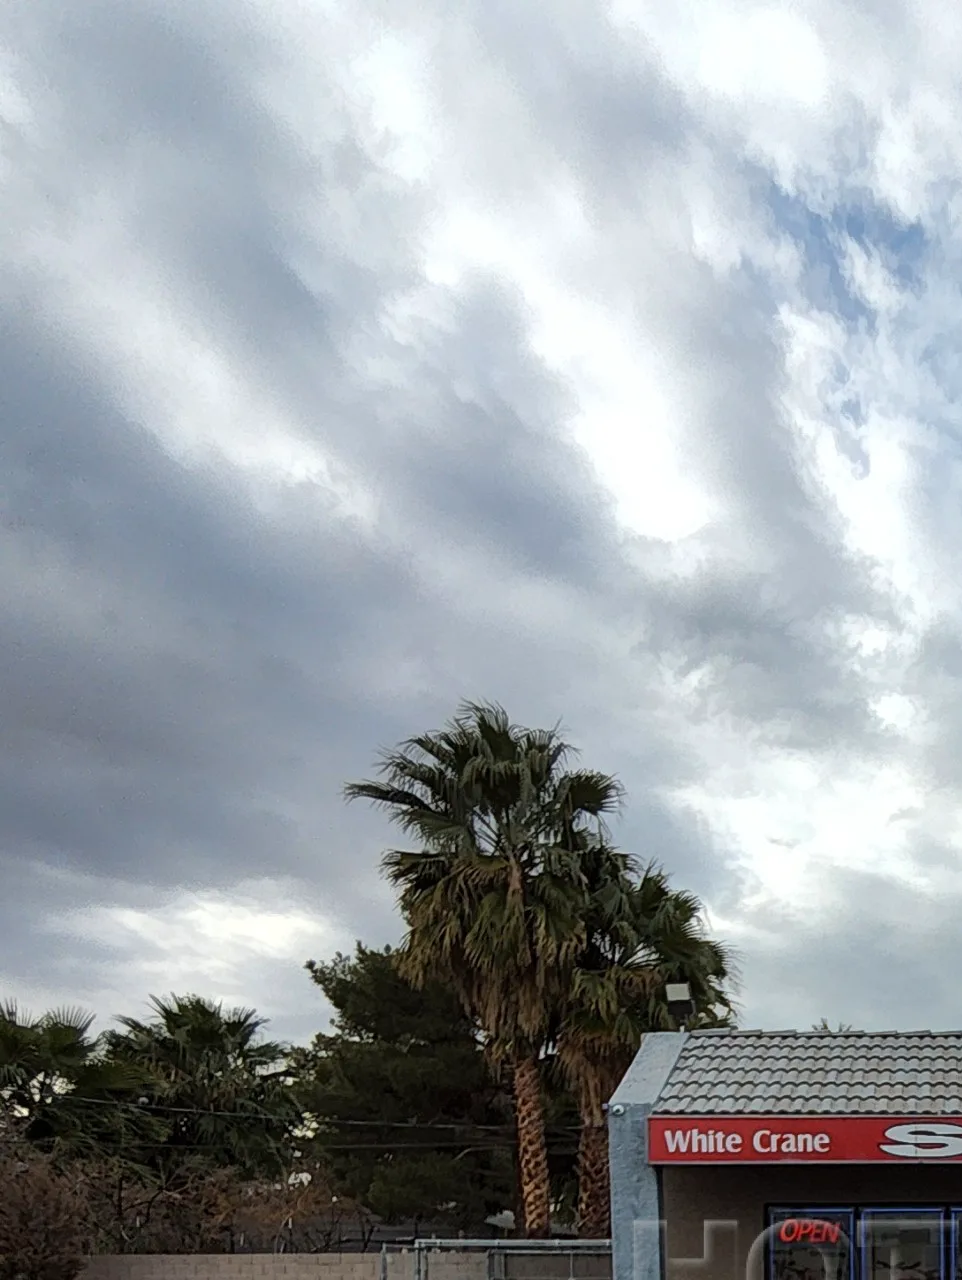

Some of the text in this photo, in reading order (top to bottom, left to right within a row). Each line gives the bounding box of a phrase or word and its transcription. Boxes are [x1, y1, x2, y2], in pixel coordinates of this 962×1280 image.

[664, 1129, 742, 1153] White
[752, 1130, 830, 1153] Crane
[779, 1218, 841, 1244] OPEN
